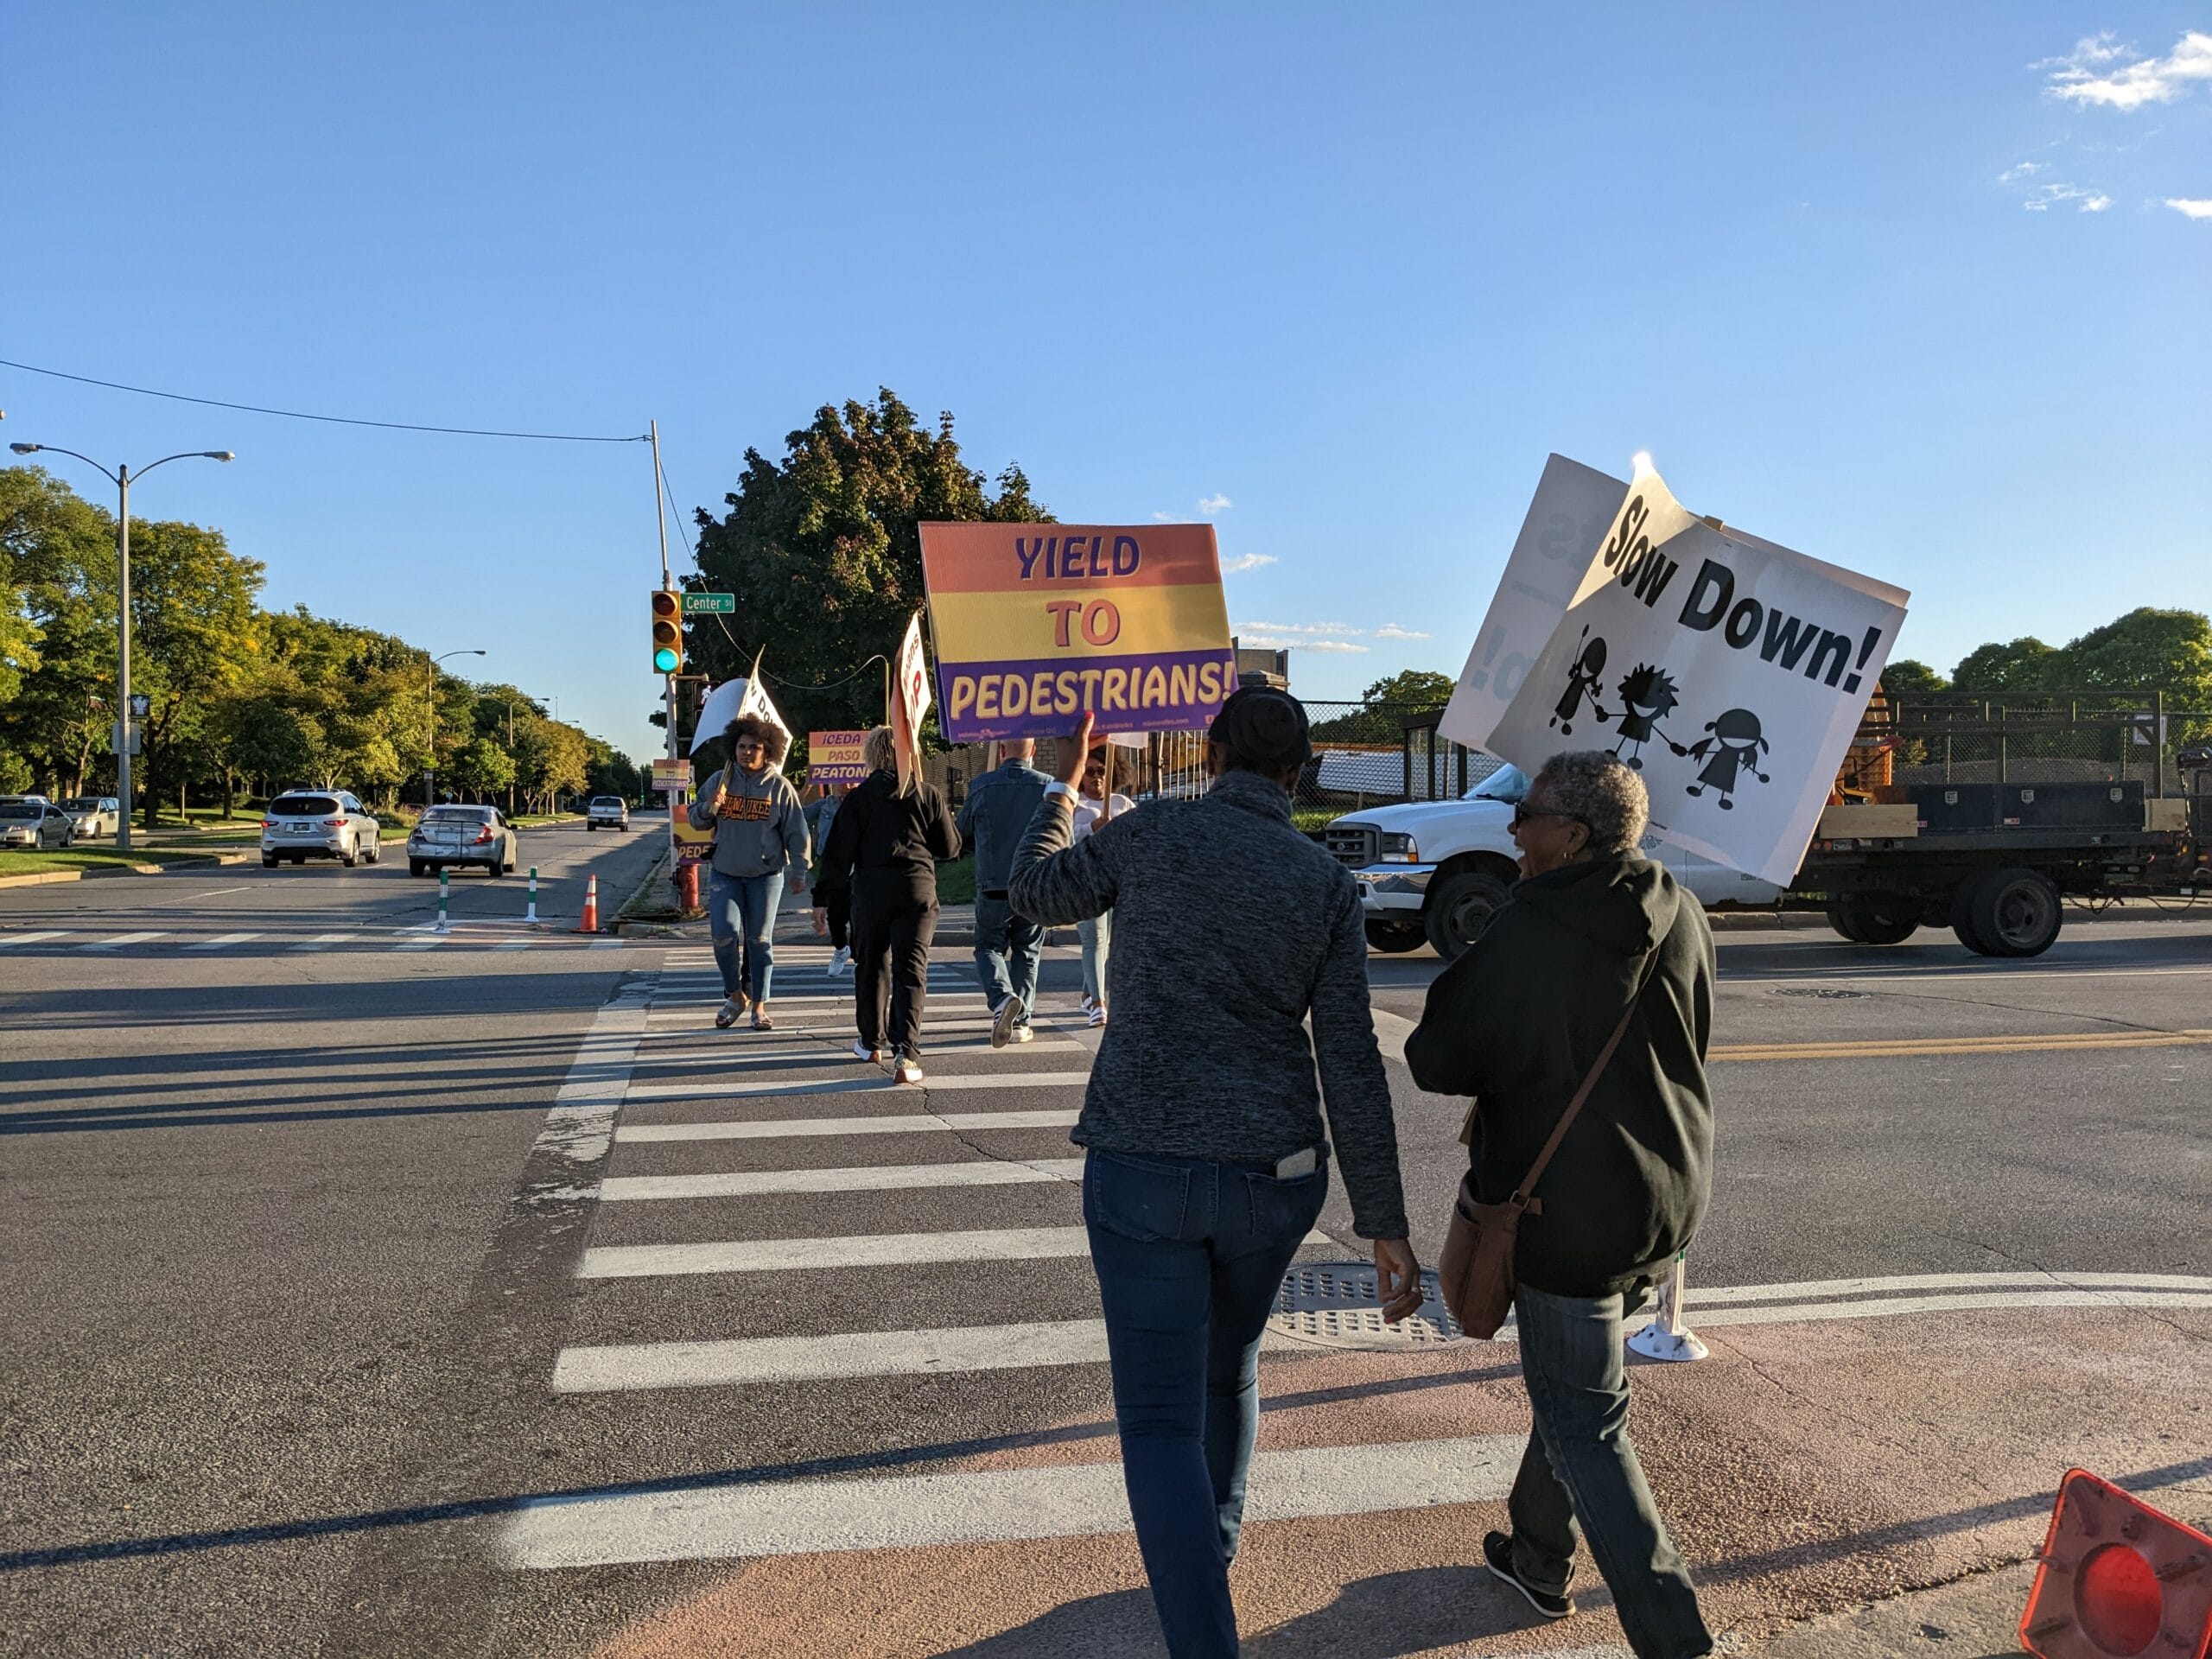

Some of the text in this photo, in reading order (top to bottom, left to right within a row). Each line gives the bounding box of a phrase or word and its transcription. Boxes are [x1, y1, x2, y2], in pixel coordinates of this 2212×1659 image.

[1015, 535, 1142, 581] YIELD
[686, 595, 721, 610] Center
[1603, 494, 1679, 608] Slow
[1677, 557, 1883, 696] Down!
[1046, 598, 1121, 647] TO
[950, 659, 1234, 721] PEDESTRIANS!
[827, 750, 861, 761] PASO
